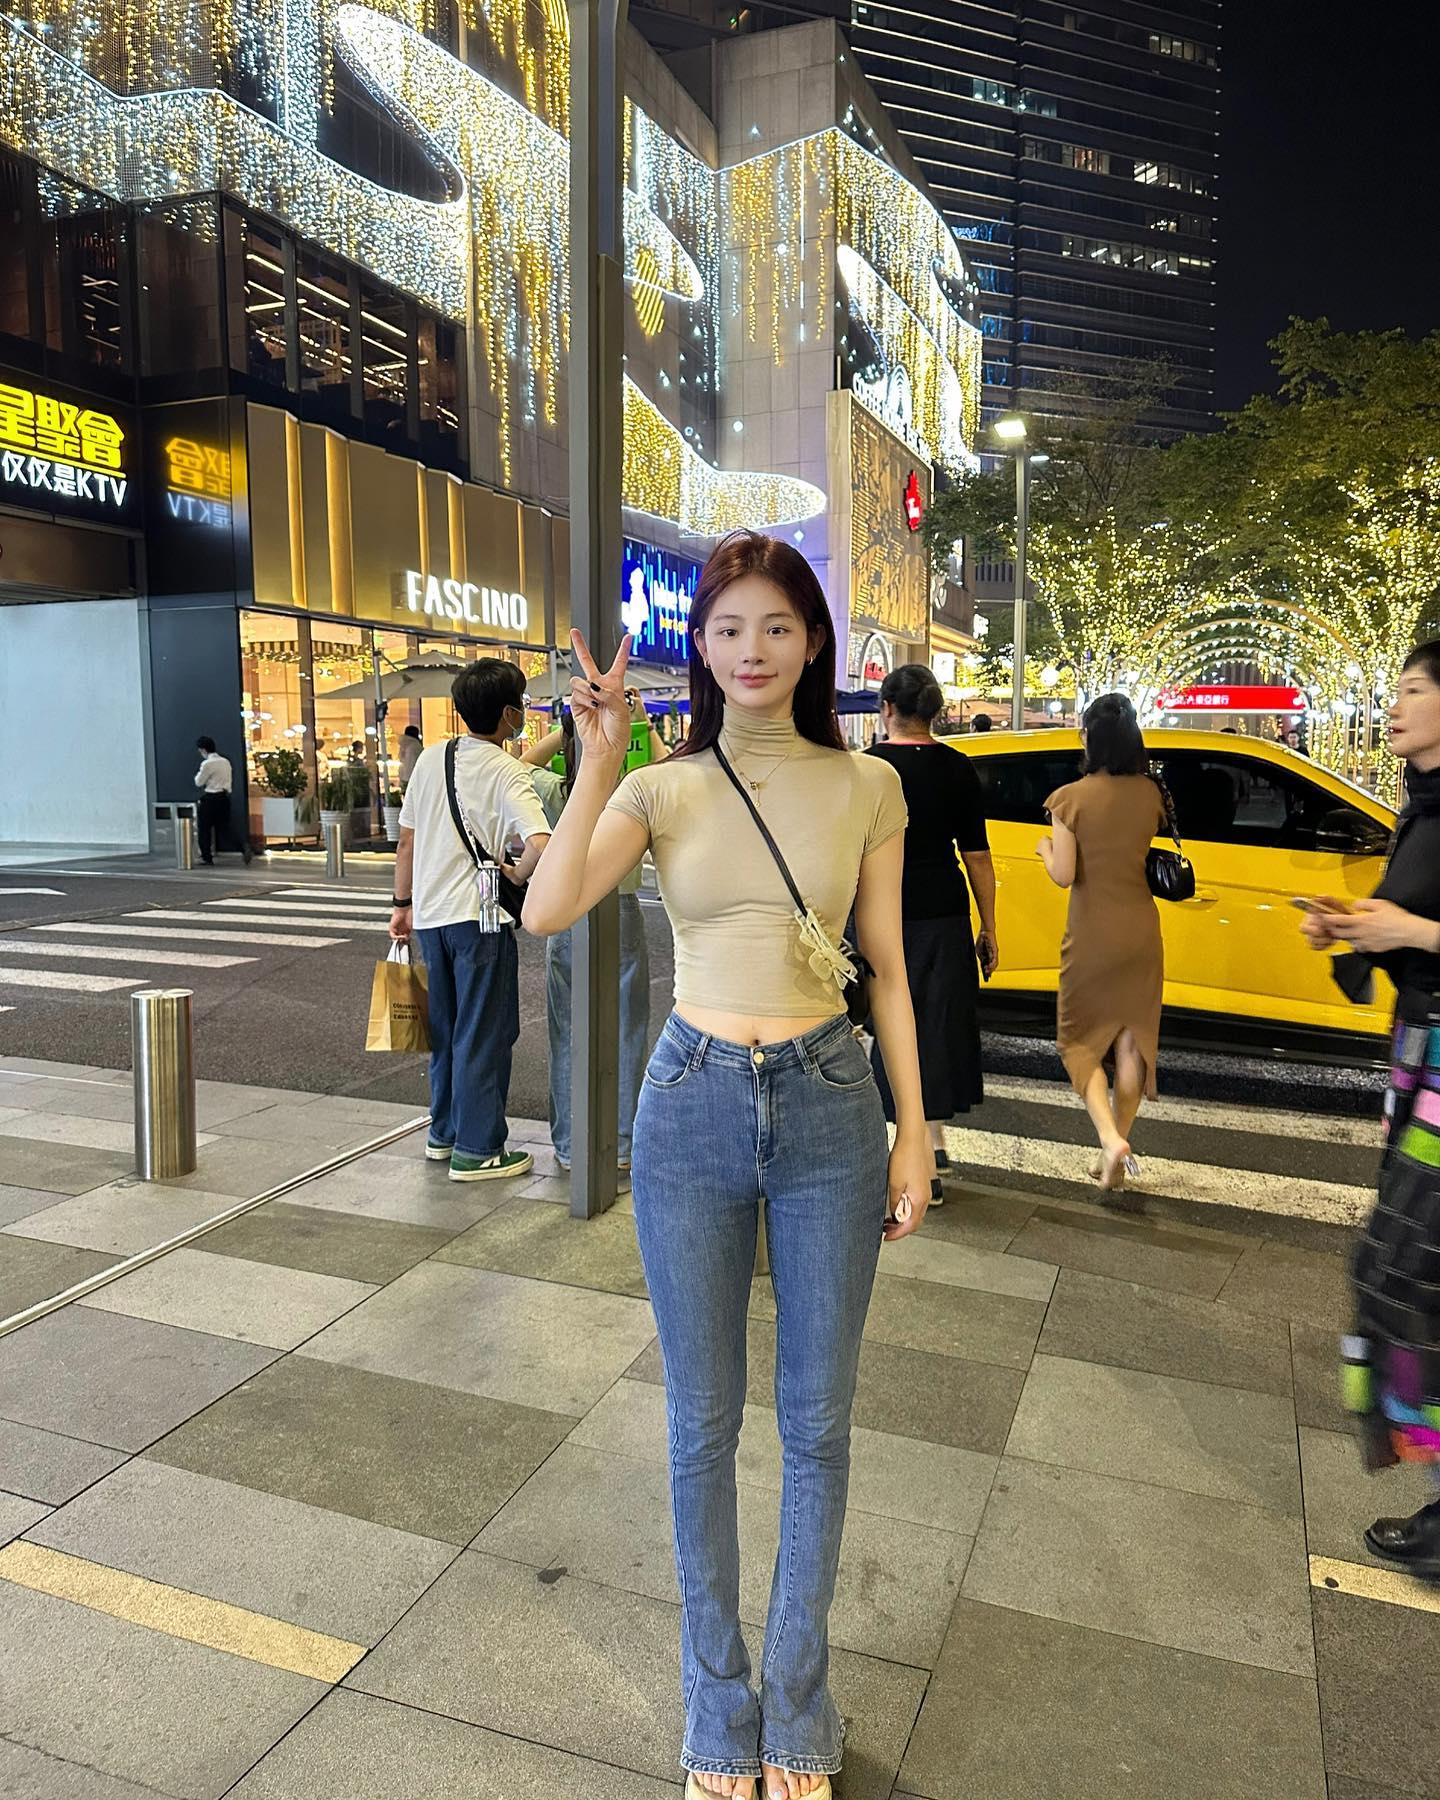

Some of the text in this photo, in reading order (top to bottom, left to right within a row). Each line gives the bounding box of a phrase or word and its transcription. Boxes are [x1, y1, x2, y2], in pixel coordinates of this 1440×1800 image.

[1, 450, 127, 507] 仅仅是KTV
[406, 569, 528, 632] FASCINO
